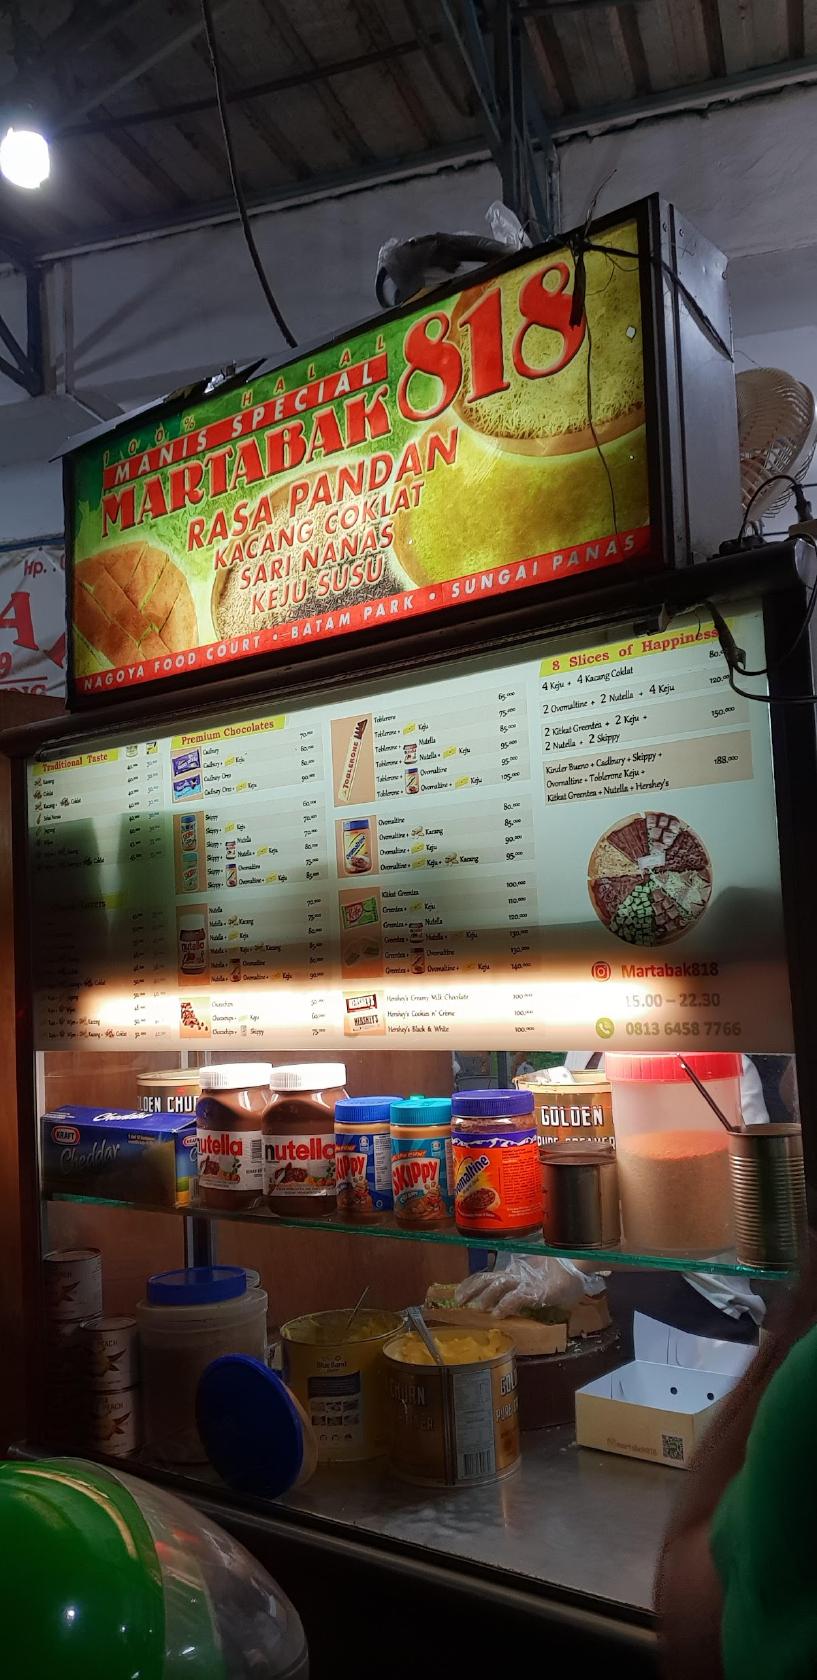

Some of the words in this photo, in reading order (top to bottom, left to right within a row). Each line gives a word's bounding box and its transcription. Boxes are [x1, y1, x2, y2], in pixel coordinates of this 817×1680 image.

[101, 385, 391, 537] MARTABAK
[397, 262, 586, 422] 818
[104, 416, 195, 467] 100%
[241, 335, 385, 407] HALAL
[115, 430, 208, 483] MANIS
[231, 363, 373, 438] SPECIAL
[187, 495, 273, 551] RASA
[289, 426, 459, 518] PANDAN
[214, 518, 313, 570] KACANG
[324, 481, 425, 535] COKLAT
[239, 556, 291, 590] SARI
[300, 521, 394, 572] NANAS
[251, 576, 307, 615] KEJU
[317, 556, 384, 597] SUSU
[84, 666, 144, 690] NAGOYA
[154, 652, 197, 673] FOOD
[206, 635, 261, 660] COURT
[291, 613, 351, 639] BATAM
[363, 595, 414, 620] PARK
[451, 567, 538, 597] SUNGAI
[552, 535, 635, 571] PANAS
[552, 661, 560, 671] 8
[569, 652, 609, 668] Slices
[619, 644, 633, 658] of
[642, 629, 719, 653] Happiness
[542, 681, 549, 691] 4
[550, 680, 565, 692] Keju
[577, 675, 584, 684] 4
[585, 671, 610, 684] Kacang
[611, 666, 633, 679] Coklat
[543, 705, 550, 714] 2
[551, 700, 588, 714] Ovomaltine
[600, 694, 607, 703] 2
[609, 691, 634, 702] Nutella
[649, 684, 656, 694] 4
[658, 684, 675, 696] Keju
[181, 732, 221, 745] Premium
[224, 720, 274, 737] Chocolates
[544, 727, 551, 737] 2
[552, 725, 572, 736] Kitkat
[573, 721, 602, 733] Greentea
[615, 715, 622, 725] 2
[624, 715, 640, 727] Keju
[545, 741, 551, 751] 2
[552, 739, 576, 750] Nutella
[589, 734, 595, 743] 2
[597, 733, 620, 743] Skippy
[43, 757, 83, 772] Traditional
[87, 753, 108, 764] Taste
[546, 763, 567, 774] Kinder
[568, 760, 589, 771] Bueno
[596, 755, 626, 770] Cadbury
[632, 751, 657, 763] Skippy
[546, 776, 583, 788] Ovomaltine
[589, 771, 622, 782] Toblerone
[624, 769, 640, 781] Keju
[547, 792, 567, 802] Kitkat
[568, 789, 597, 800] Greentea
[604, 785, 629, 795] Nutella
[635, 780, 669, 792] Hershey's
[621, 962, 719, 978] Martabak818
[626, 994, 662, 1007] 15.00
[679, 993, 720, 1007] 22.30
[625, 1022, 660, 1036] 0813
[664, 1022, 700, 1036] 6458
[704, 1022, 741, 1036] 7766
[541, 1105, 603, 1127] GOLDEN
[56, 1131, 75, 1140] KRAFT
[59, 1139, 120, 1175] Cheddar
[264, 1136, 336, 1161] nutella
[336, 1155, 365, 1180] KIPPY
[392, 1160, 438, 1196] SKIPPY
